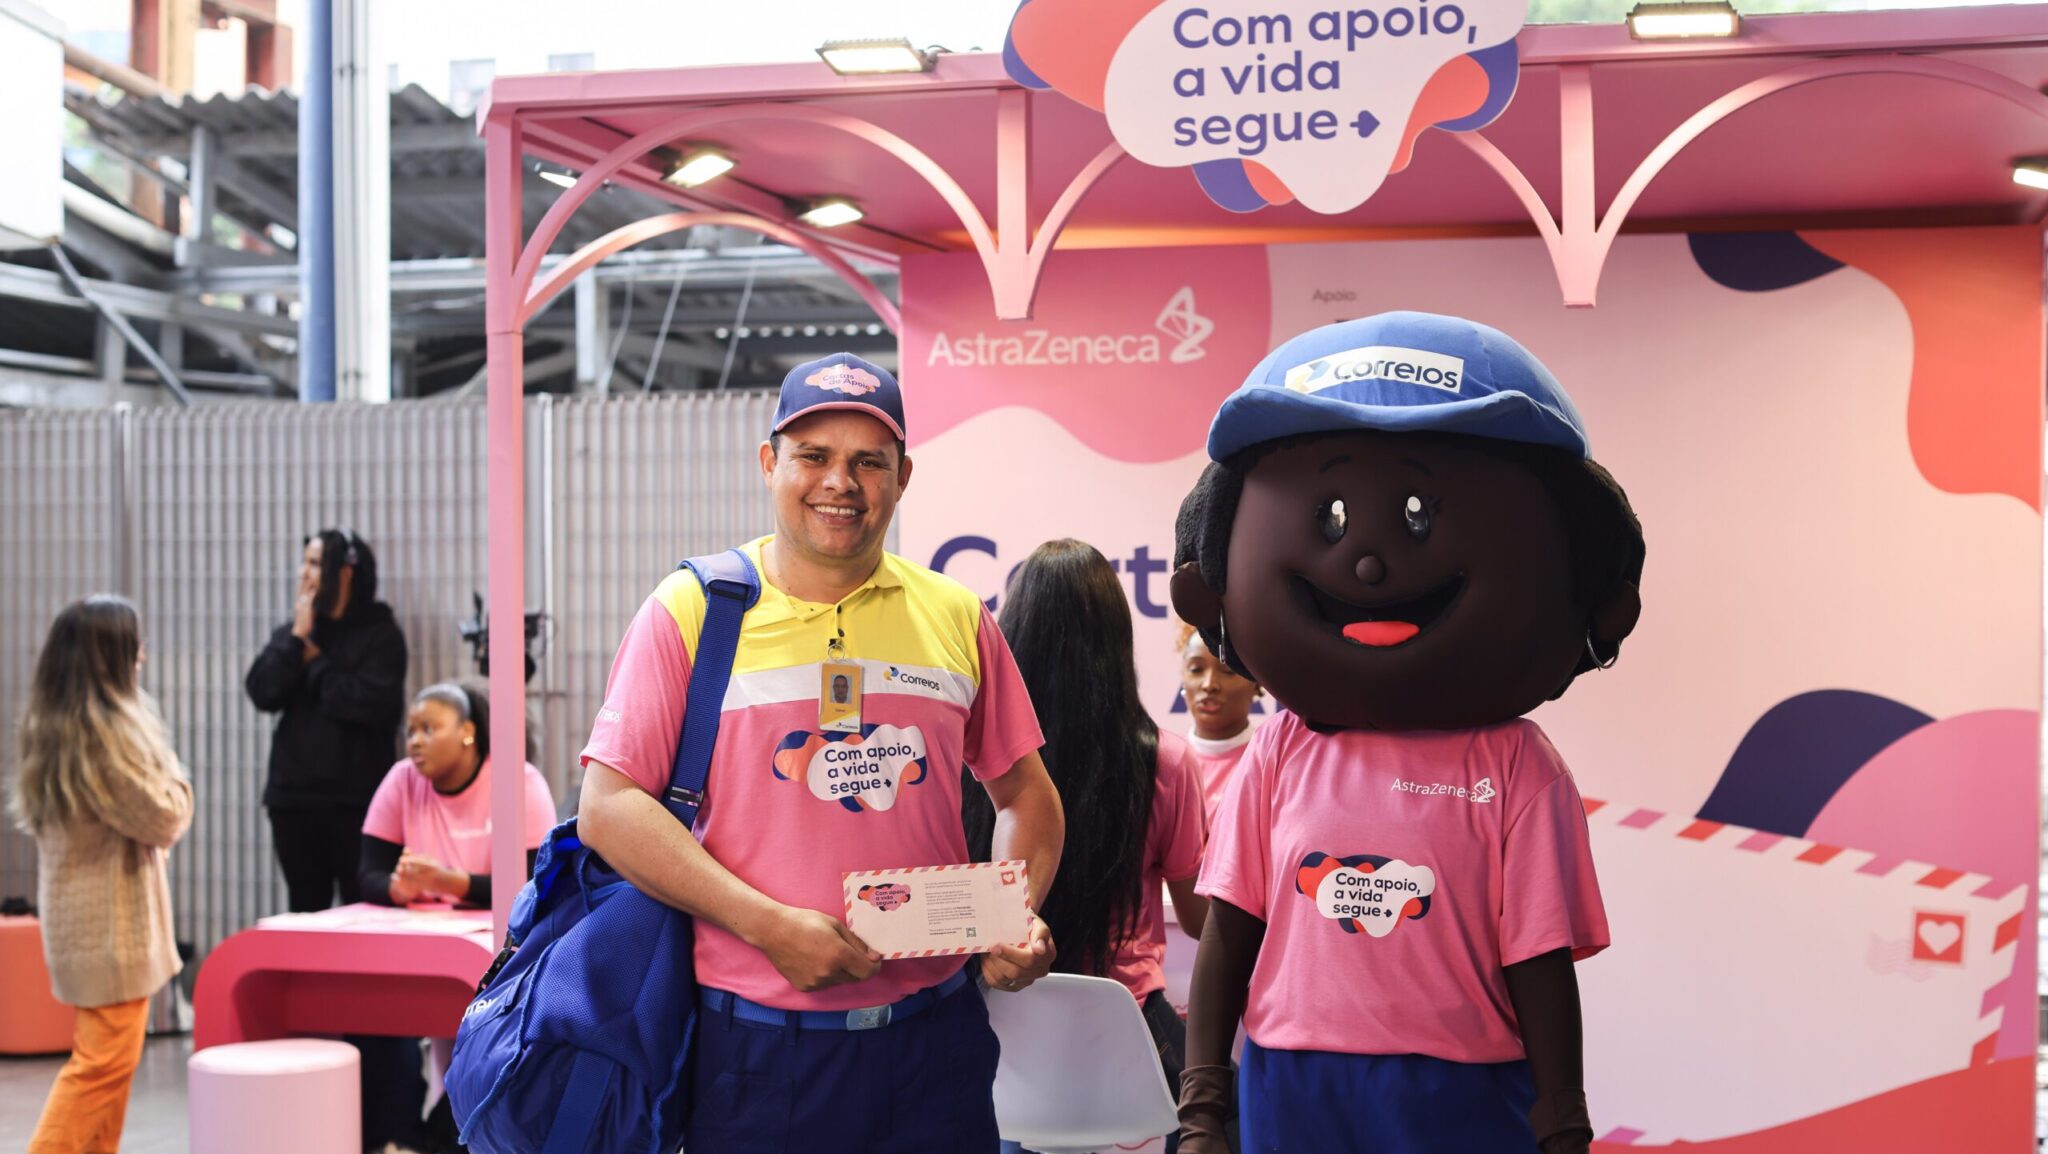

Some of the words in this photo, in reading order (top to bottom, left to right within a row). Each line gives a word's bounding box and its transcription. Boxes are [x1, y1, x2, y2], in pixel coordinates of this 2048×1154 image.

[1172, 7, 1292, 49] Com
[1307, 0, 1478, 51] apoio,
[1172, 66, 1205, 98] a
[1220, 50, 1341, 95] vida
[1172, 110, 1339, 156] segue
[927, 330, 1160, 367] AstraZeneca
[825, 750, 862, 761] Com
[867, 743, 915, 761] apoio,
[828, 766, 839, 778] a
[842, 760, 880, 776] vida
[830, 778, 881, 794] segue
[1391, 778, 1478, 803] AstraZeneca
[1336, 872, 1370, 887] Com
[1374, 878, 1421, 895] apoio,
[1334, 889, 1344, 899] a
[1348, 888, 1383, 903] vida
[1333, 901, 1381, 918] segue
